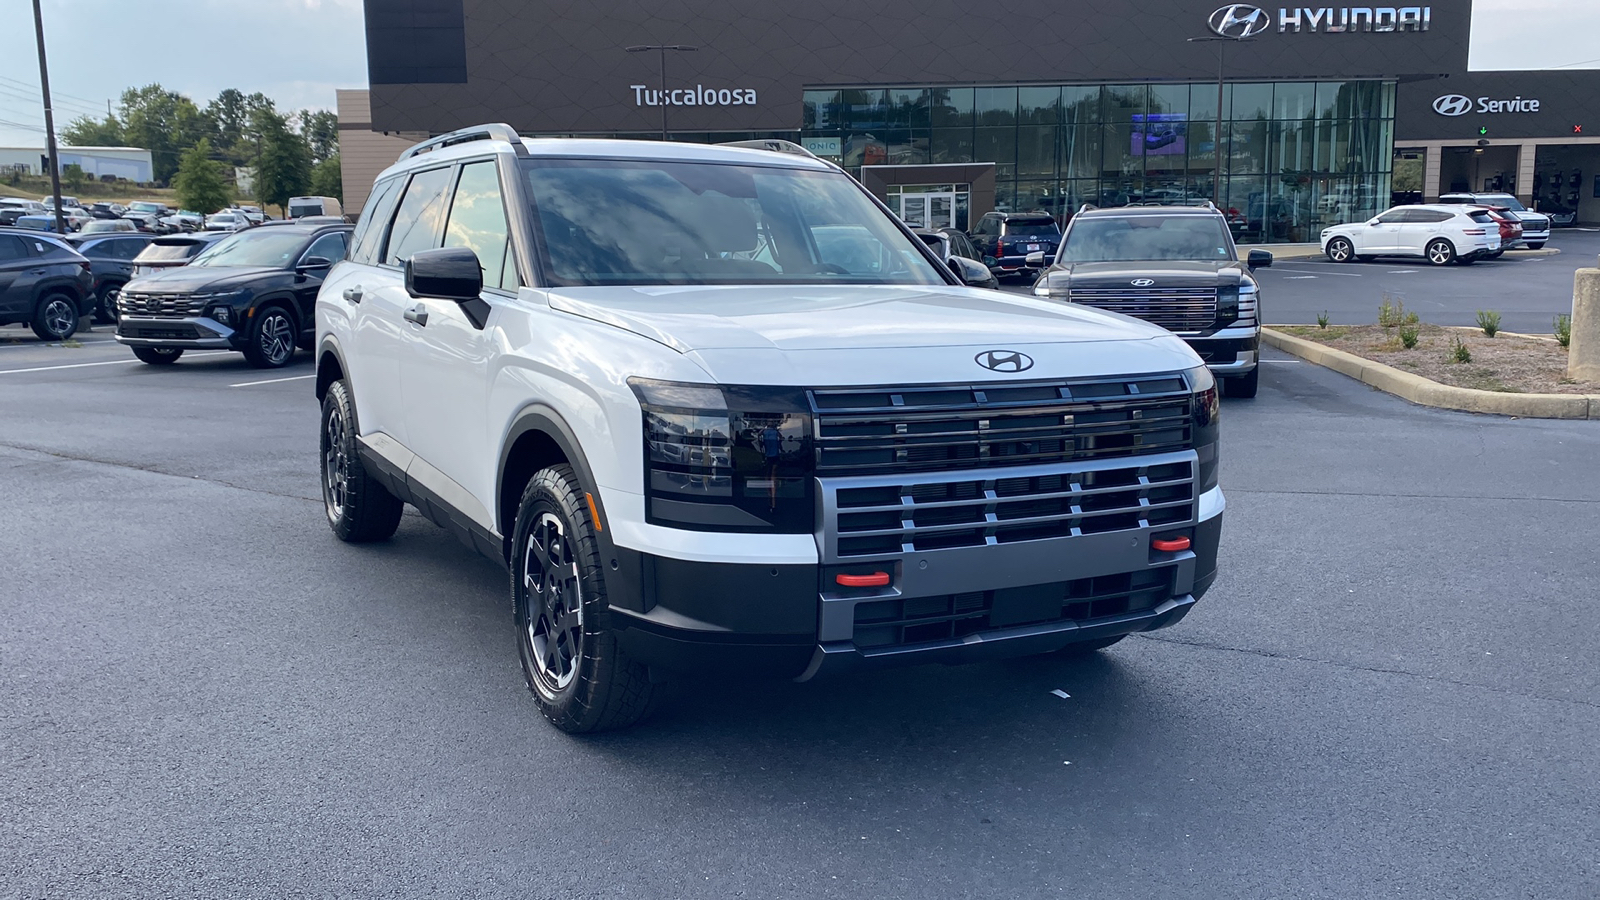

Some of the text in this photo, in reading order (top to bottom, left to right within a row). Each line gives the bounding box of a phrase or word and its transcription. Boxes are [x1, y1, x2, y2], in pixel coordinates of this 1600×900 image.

[1278, 6, 1431, 33] HYUNDAI
[629, 84, 757, 106] Tuscaloosa
[1476, 95, 1540, 114] Service
